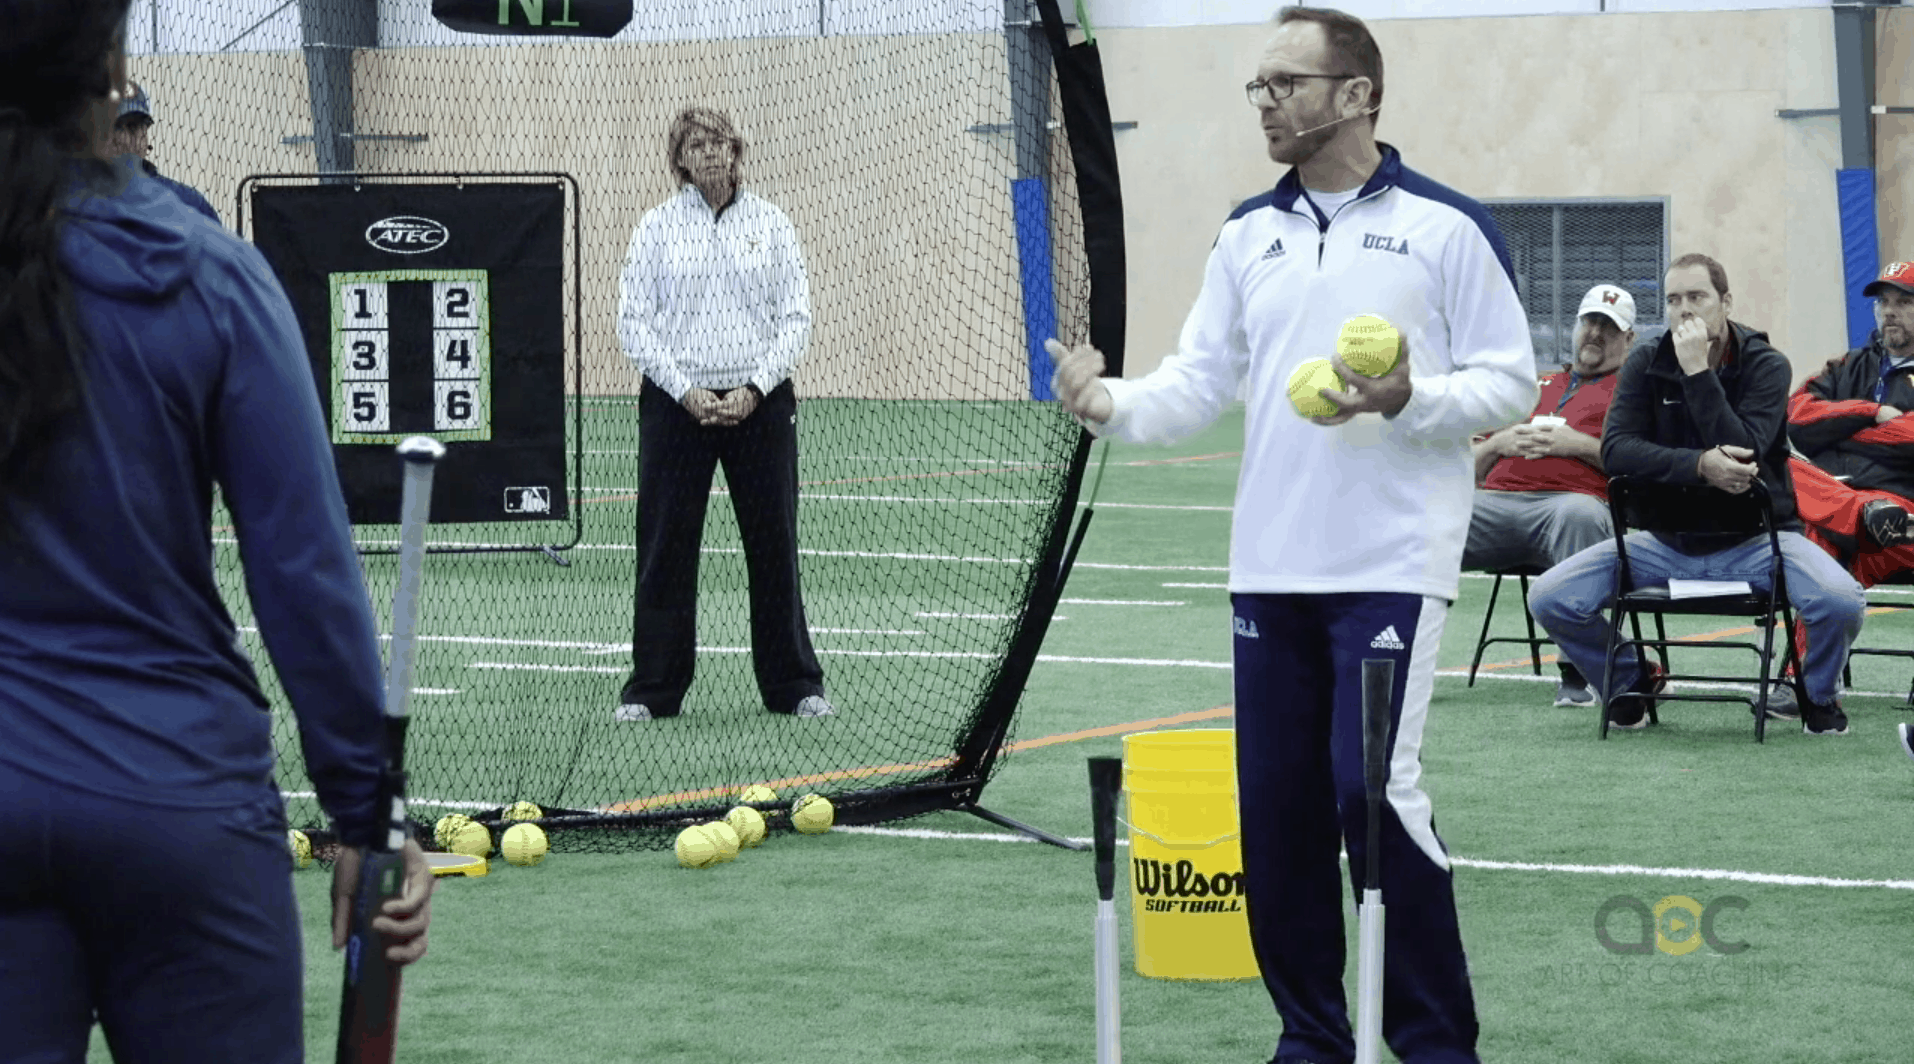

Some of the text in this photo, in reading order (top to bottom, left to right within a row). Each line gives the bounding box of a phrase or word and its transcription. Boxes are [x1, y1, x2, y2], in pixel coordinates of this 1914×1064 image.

[374, 229, 442, 243] ATEC
[1362, 232, 1409, 256] UCLA
[353, 287, 470, 319] 1 2
[352, 339, 471, 371] 3 4
[352, 390, 472, 423] 5 6
[1370, 640, 1405, 650] adidas
[1145, 898, 1241, 913] SOFTBALL
